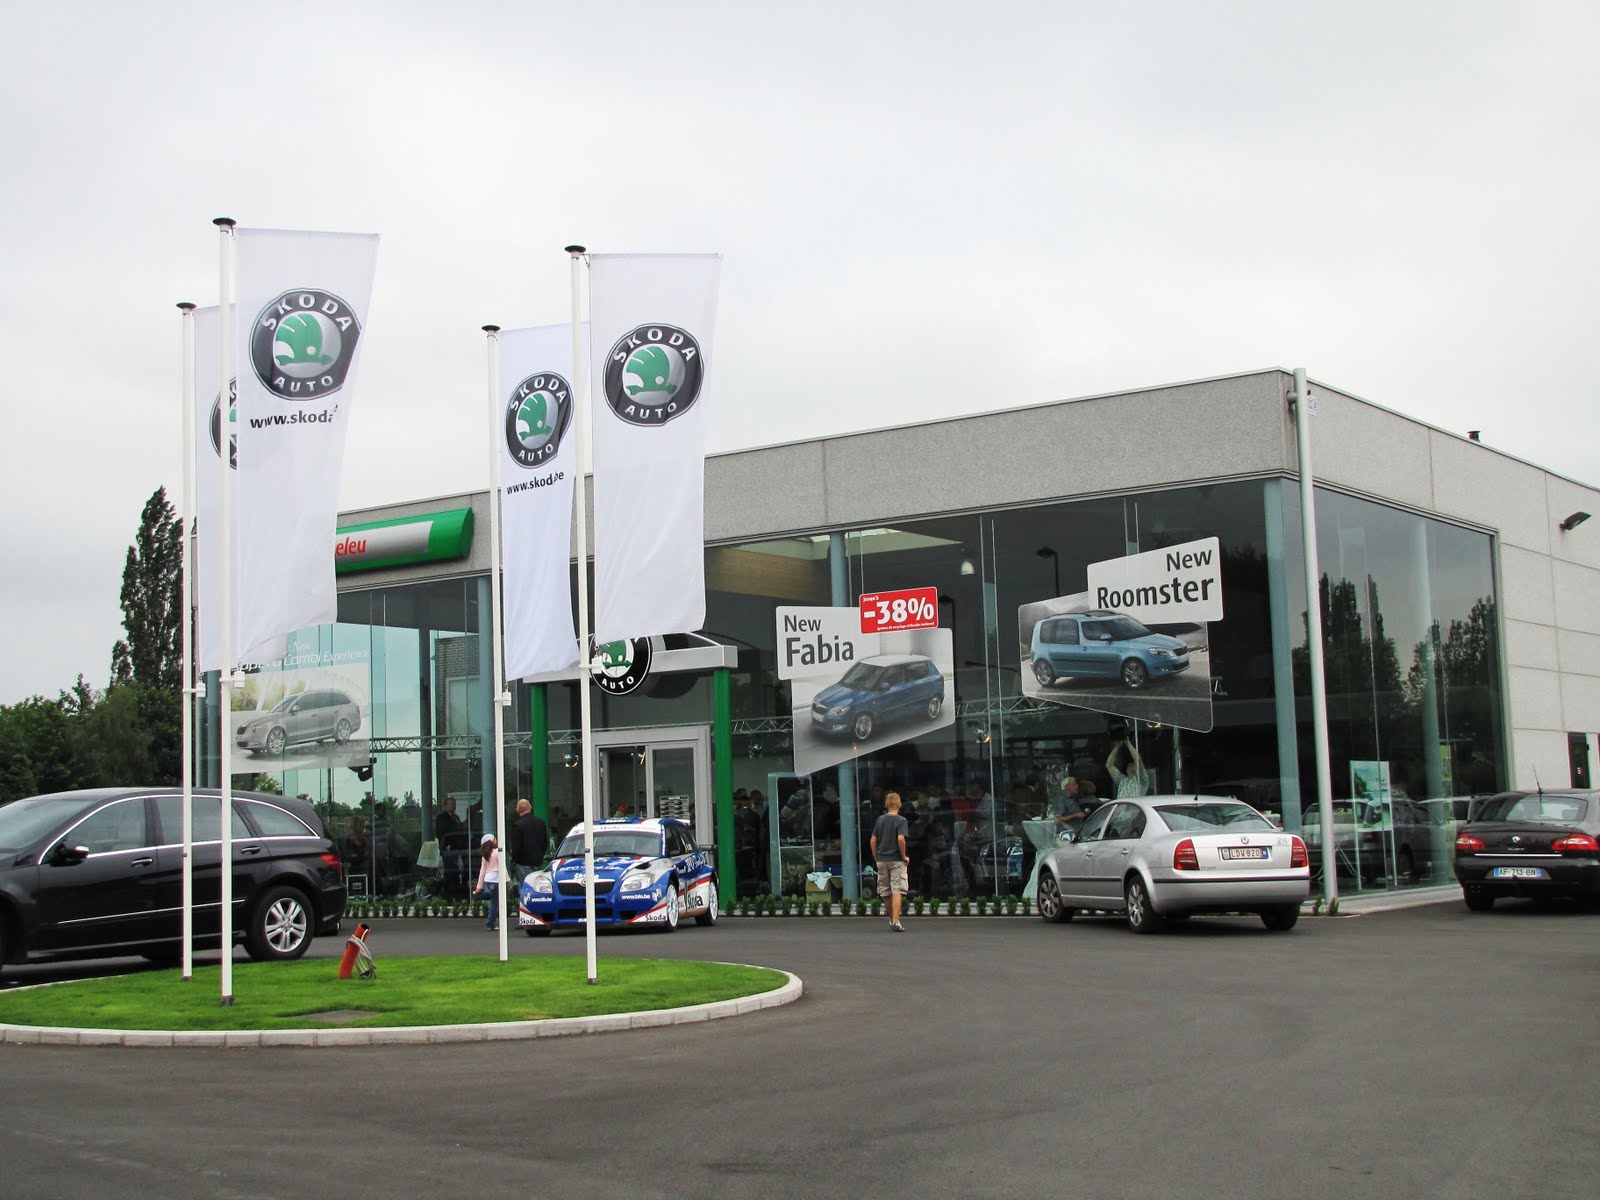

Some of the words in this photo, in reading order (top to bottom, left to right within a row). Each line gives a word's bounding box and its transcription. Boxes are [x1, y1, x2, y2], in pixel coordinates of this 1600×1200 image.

[273, 375, 333, 393] AUTO
[625, 402, 676, 419] AUTO
[519, 443, 554, 461] AUTO
[1166, 549, 1212, 572] New
[1097, 577, 1214, 609] Roomster
[864, 597, 935, 625] -38%
[784, 614, 821, 633] New
[294, 641, 311, 651] New
[786, 634, 854, 667] Fabia
[602, 676, 634, 689] AUTO
